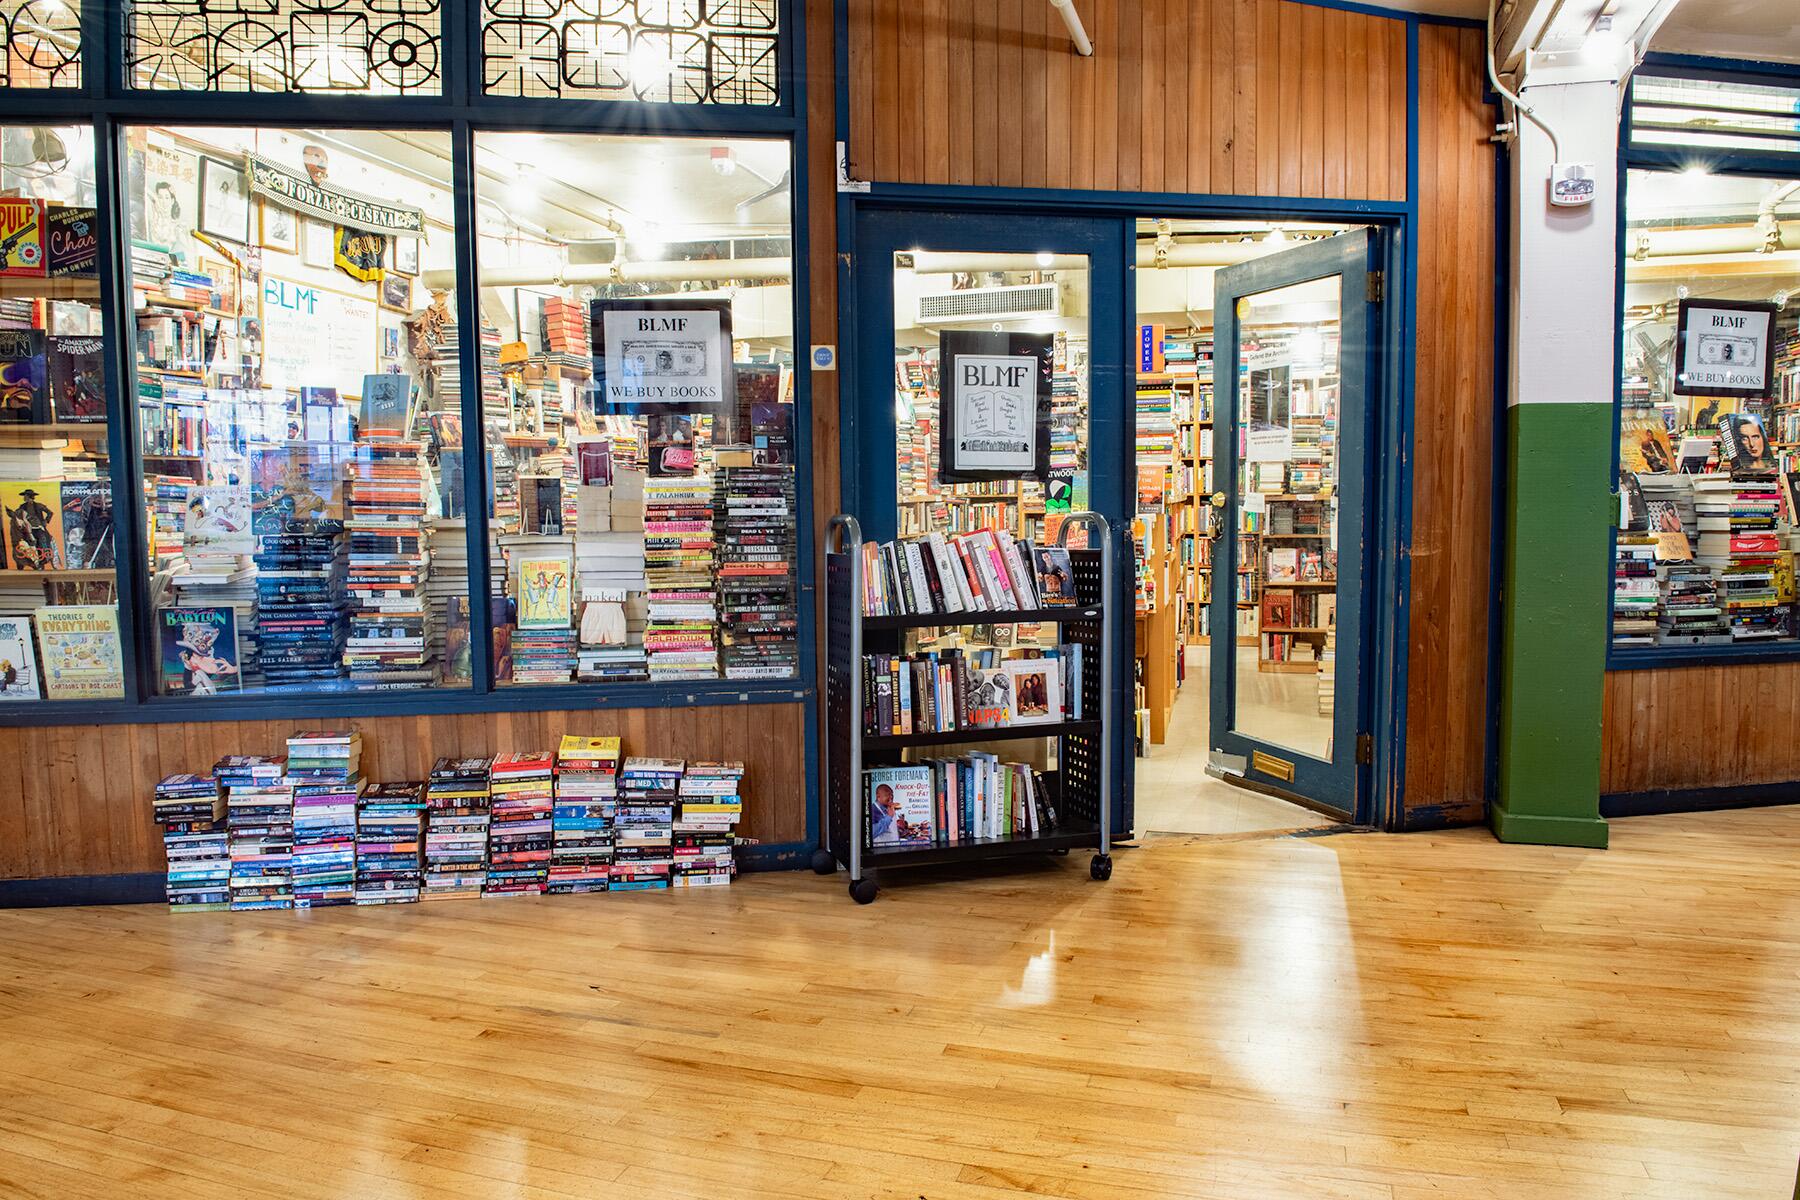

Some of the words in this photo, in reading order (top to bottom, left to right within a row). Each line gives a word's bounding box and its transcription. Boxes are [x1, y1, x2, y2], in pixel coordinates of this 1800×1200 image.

[287, 178, 332, 211] FORZA
[350, 206, 397, 228] CESENA
[1564, 194, 1585, 202] FIRE
[0, 206, 34, 234] PULP
[49, 208, 78, 222] CHARLES
[62, 210, 95, 225] BUKOWSKI
[70, 264, 80, 272] ON
[81, 259, 94, 268] RYE
[264, 279, 321, 315] BLMF
[638, 318, 688, 332] BLMF
[1711, 315, 1747, 329] BLMF
[963, 364, 1029, 388] BLMF
[1687, 372, 1703, 381] WE
[1706, 373, 1726, 383] BUY
[1729, 374, 1761, 385] BOOKS
[611, 386, 633, 397] WE
[637, 386, 666, 397] BUY
[670, 386, 717, 398] BOOKS
[16, 543, 54, 561] Saga
[585, 591, 624, 602] naked
[48, 613, 83, 621] THEORIES
[166, 611, 227, 626] BABYLON
[42, 620, 111, 632] EVERYTHING
[870, 772, 893, 782] GEORGE
[895, 770, 929, 781] FOREMAN'S
